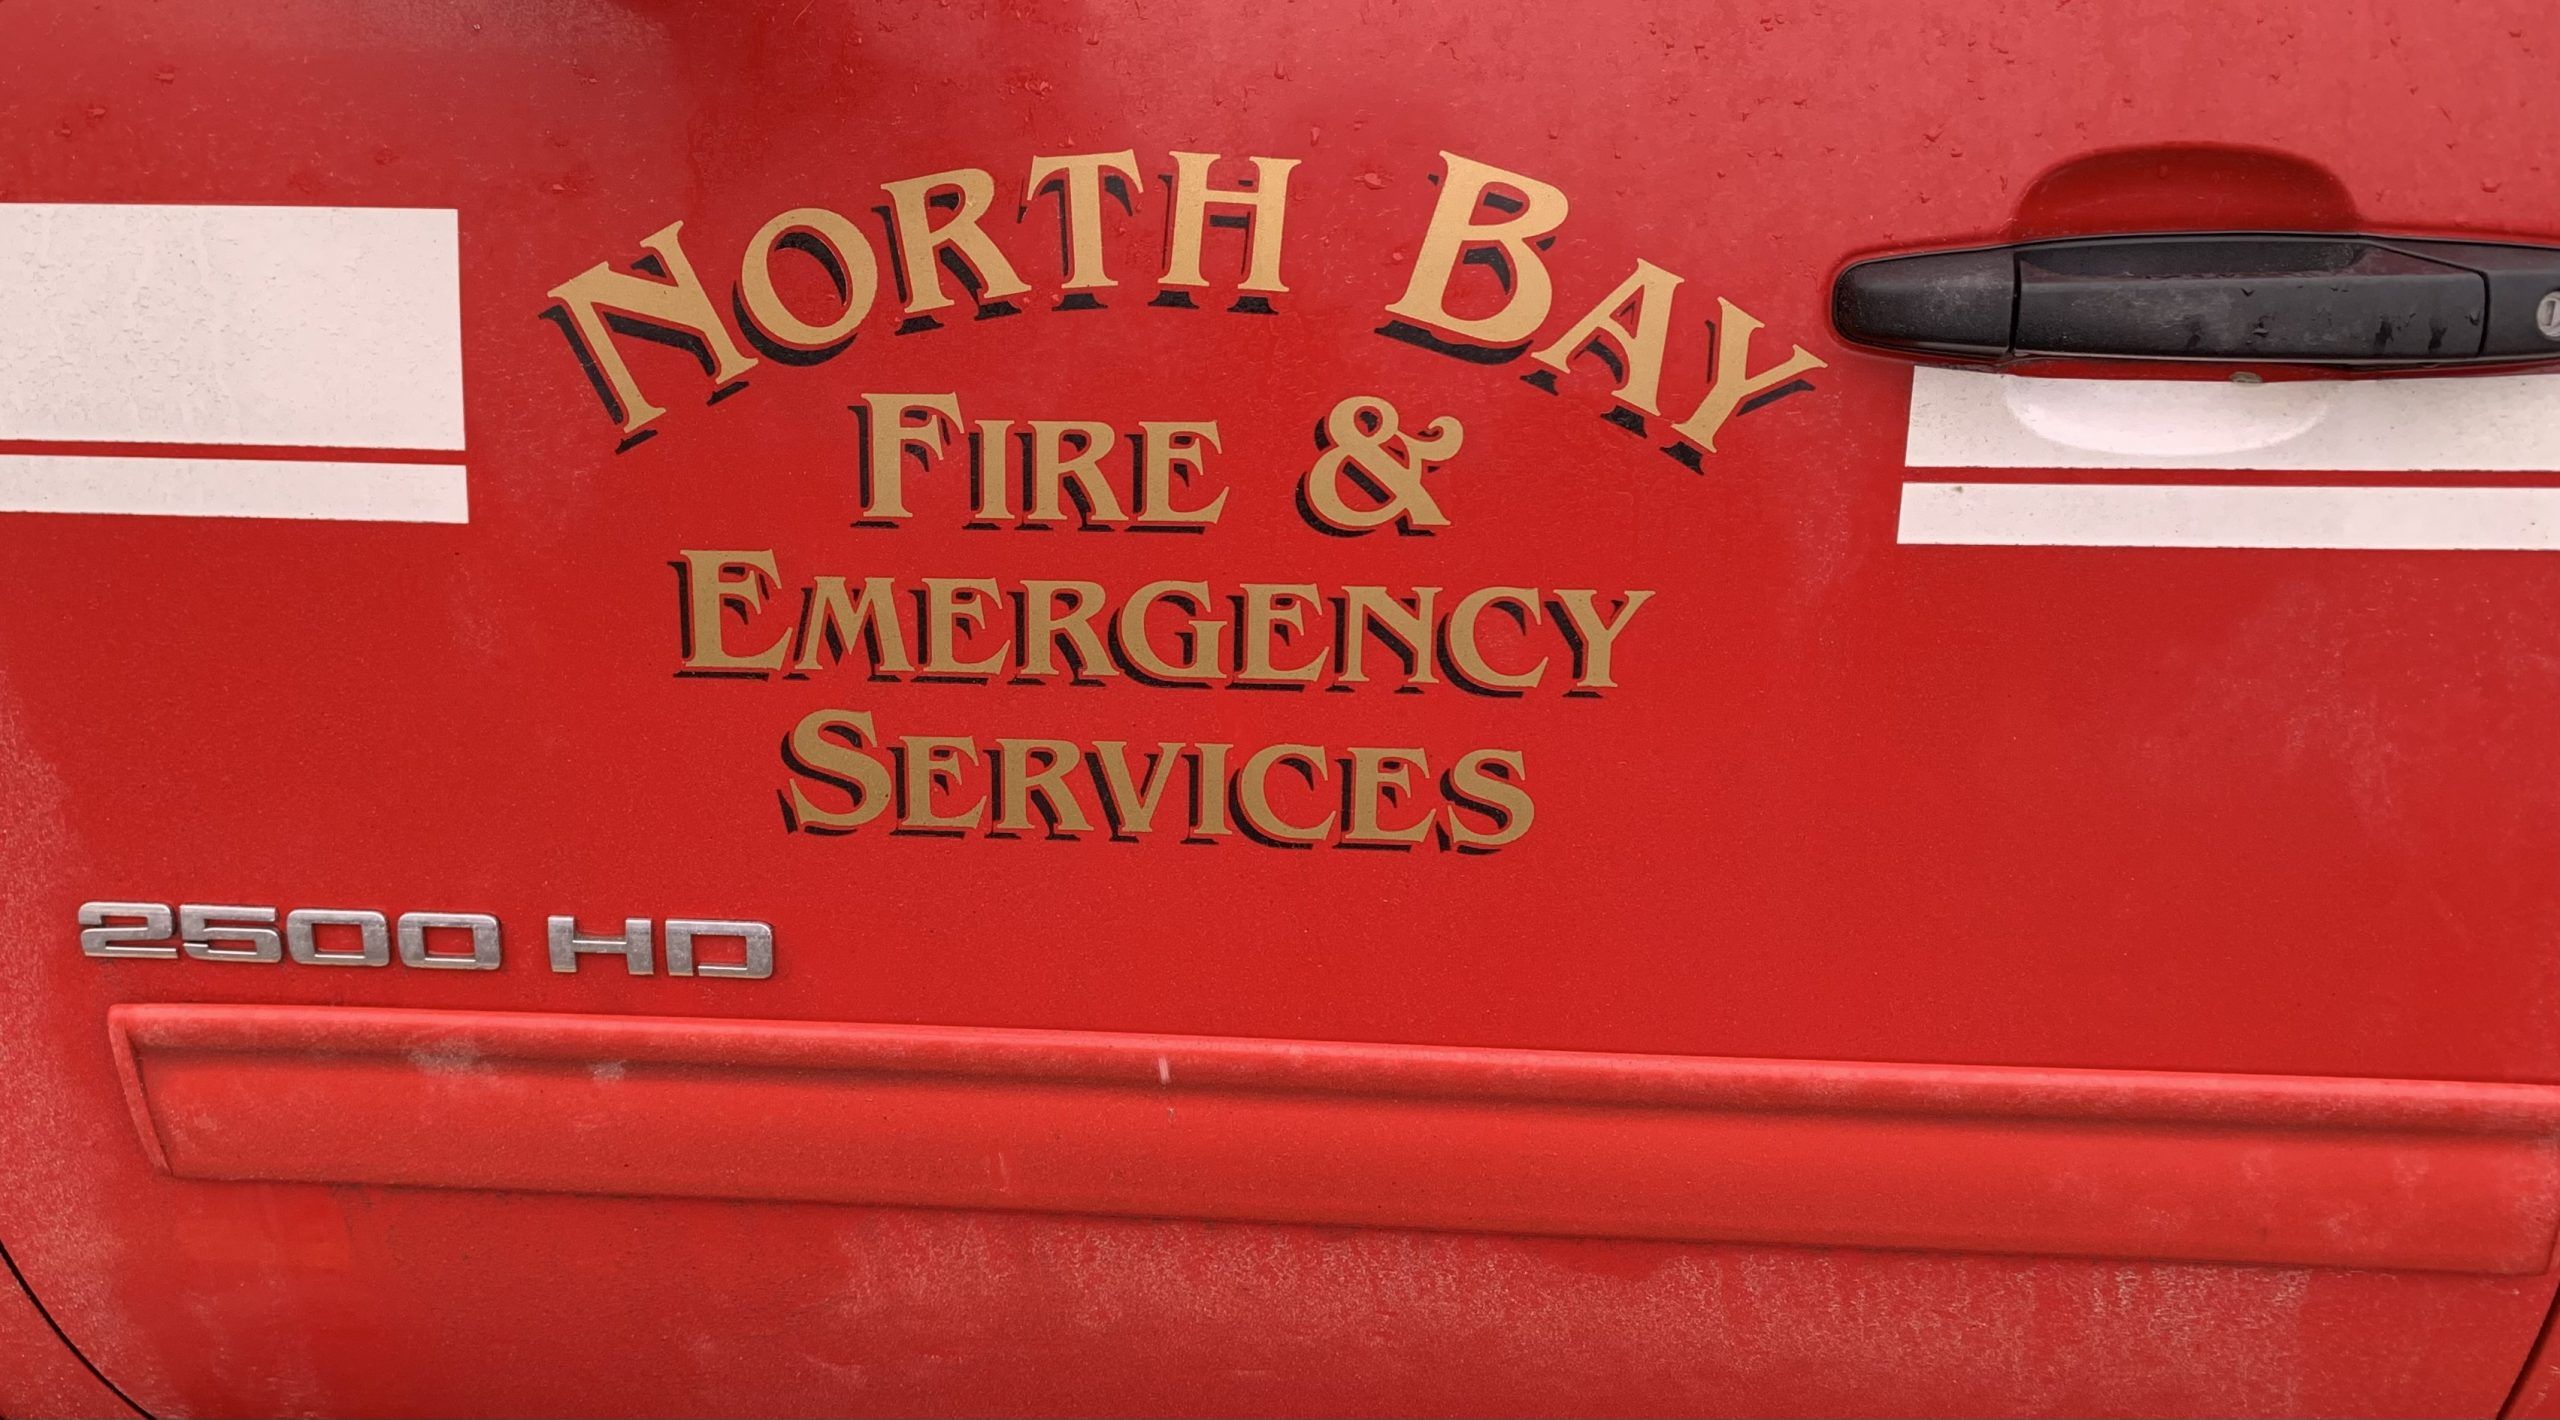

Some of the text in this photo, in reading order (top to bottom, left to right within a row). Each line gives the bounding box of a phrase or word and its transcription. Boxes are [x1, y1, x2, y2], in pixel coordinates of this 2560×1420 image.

[545, 149, 1826, 468] NORTH BAY
[857, 393, 1464, 534] FIRE &
[679, 550, 1655, 697] EMERGENCY
[784, 710, 1536, 850] SERVICES
[78, 900, 775, 980] 2500 HD
